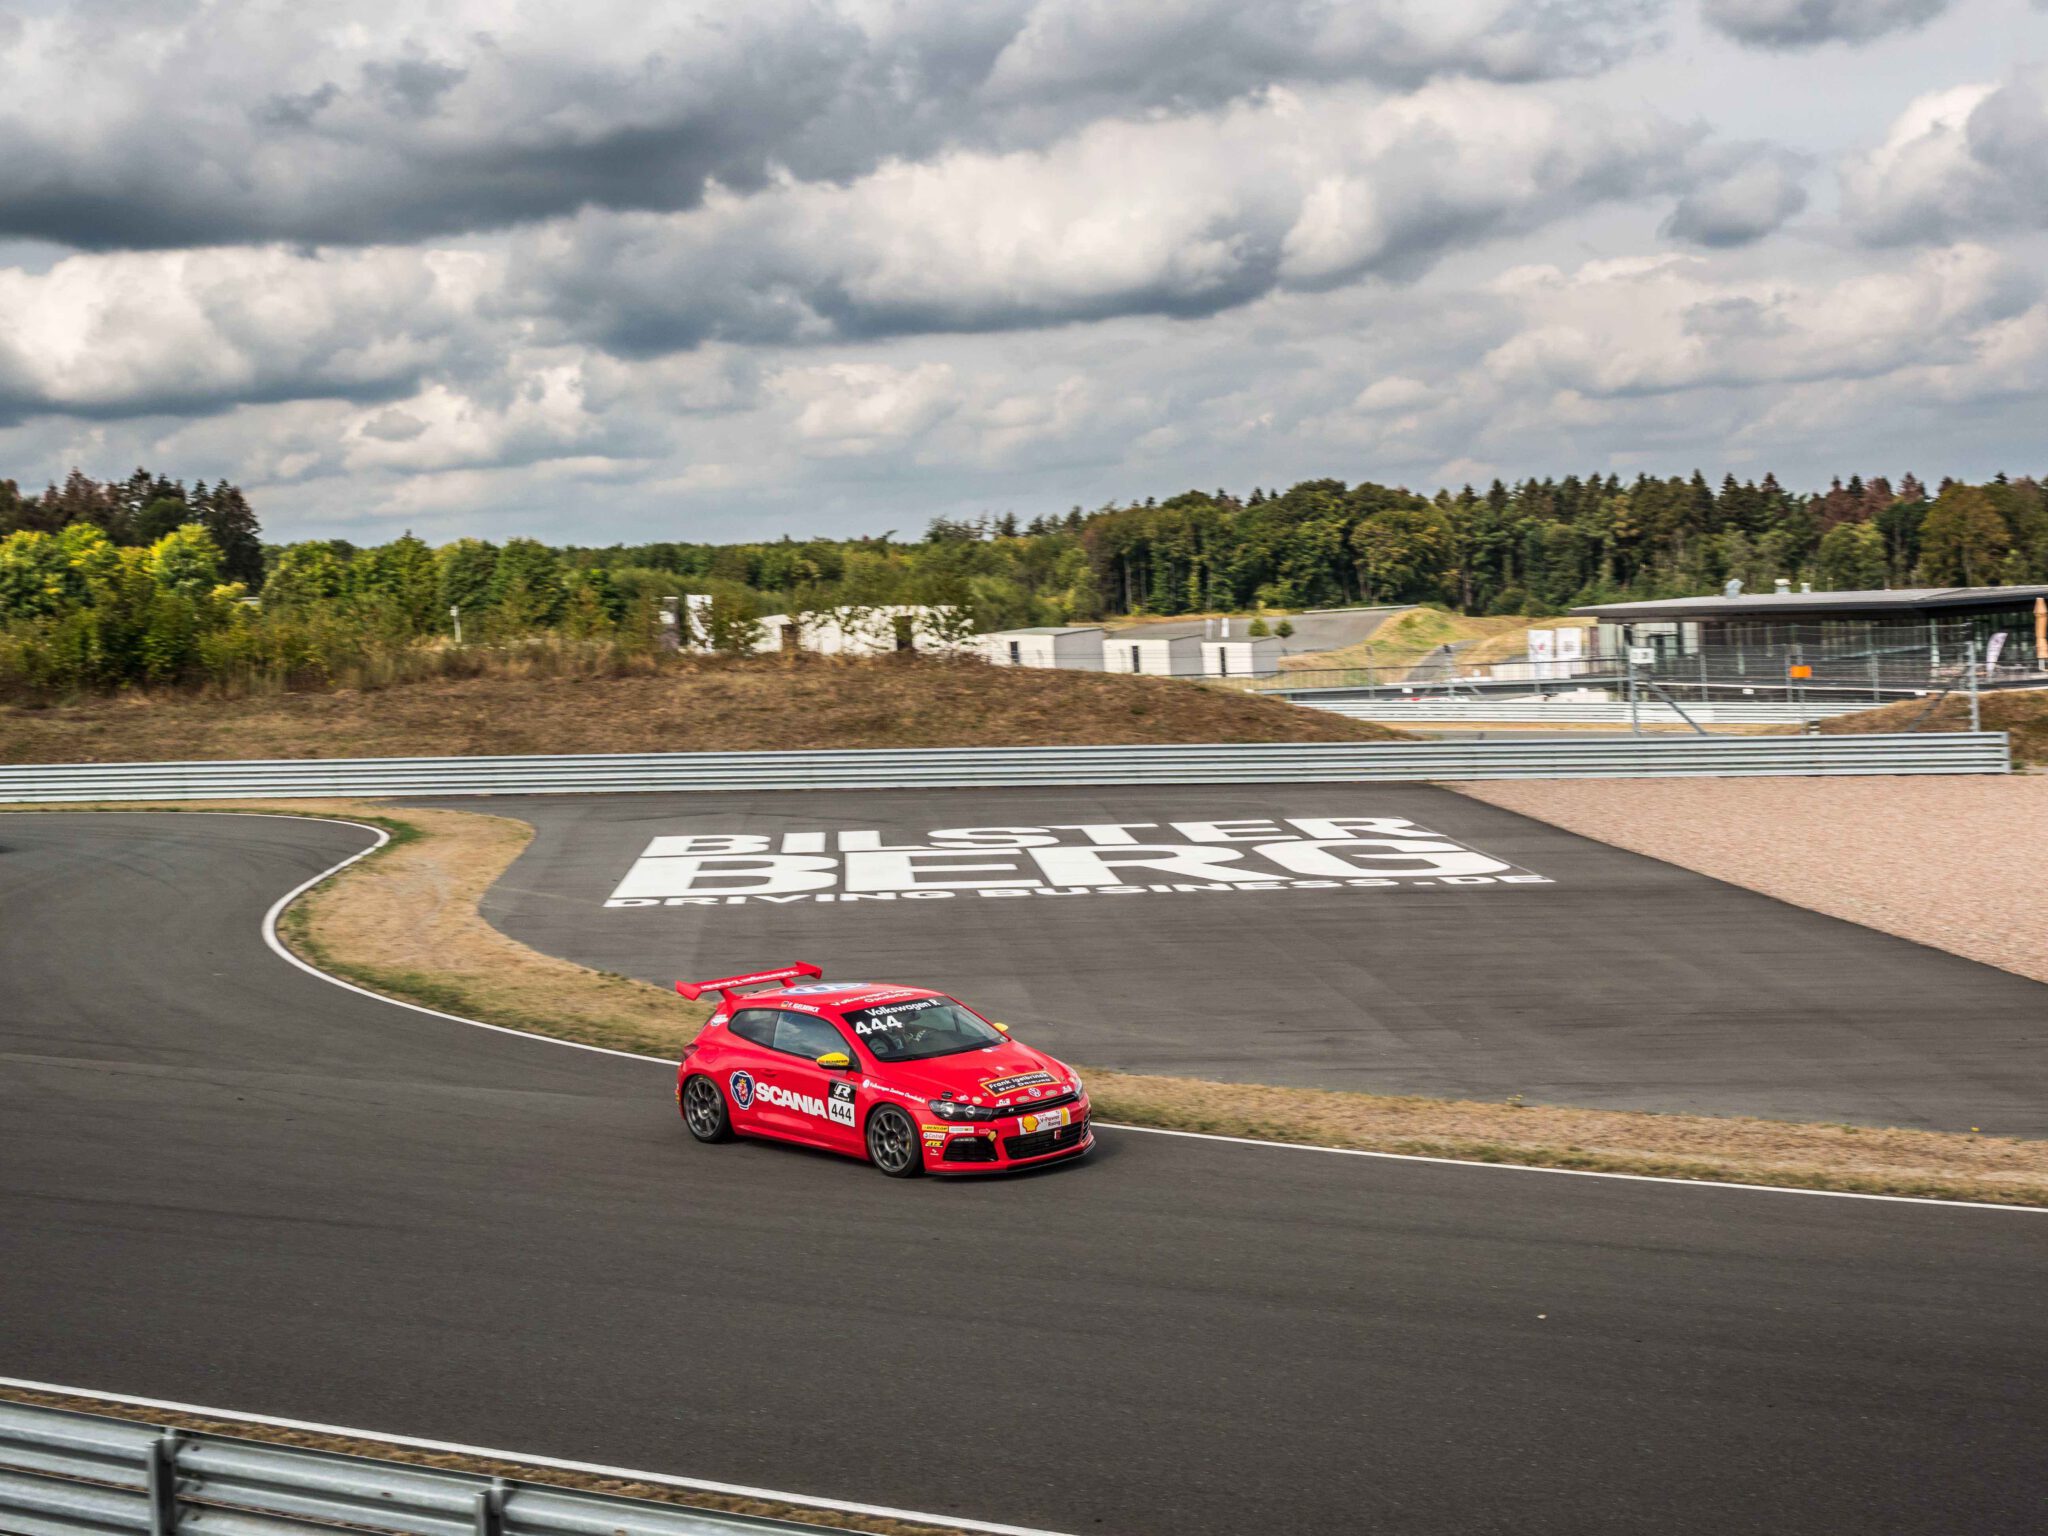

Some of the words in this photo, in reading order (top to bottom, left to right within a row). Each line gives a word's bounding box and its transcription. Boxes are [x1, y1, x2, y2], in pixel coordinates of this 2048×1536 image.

[640, 816, 1448, 858] BILSTER
[609, 838, 1512, 899] BERG
[602, 890, 956, 908] DRIVING
[864, 1001, 930, 1017] Volkswagen
[928, 998, 941, 1007] R
[855, 1015, 903, 1035] 444
[988, 1079, 1012, 1090] Frank
[755, 1081, 829, 1120] SCANIA
[831, 1103, 852, 1122] 444
